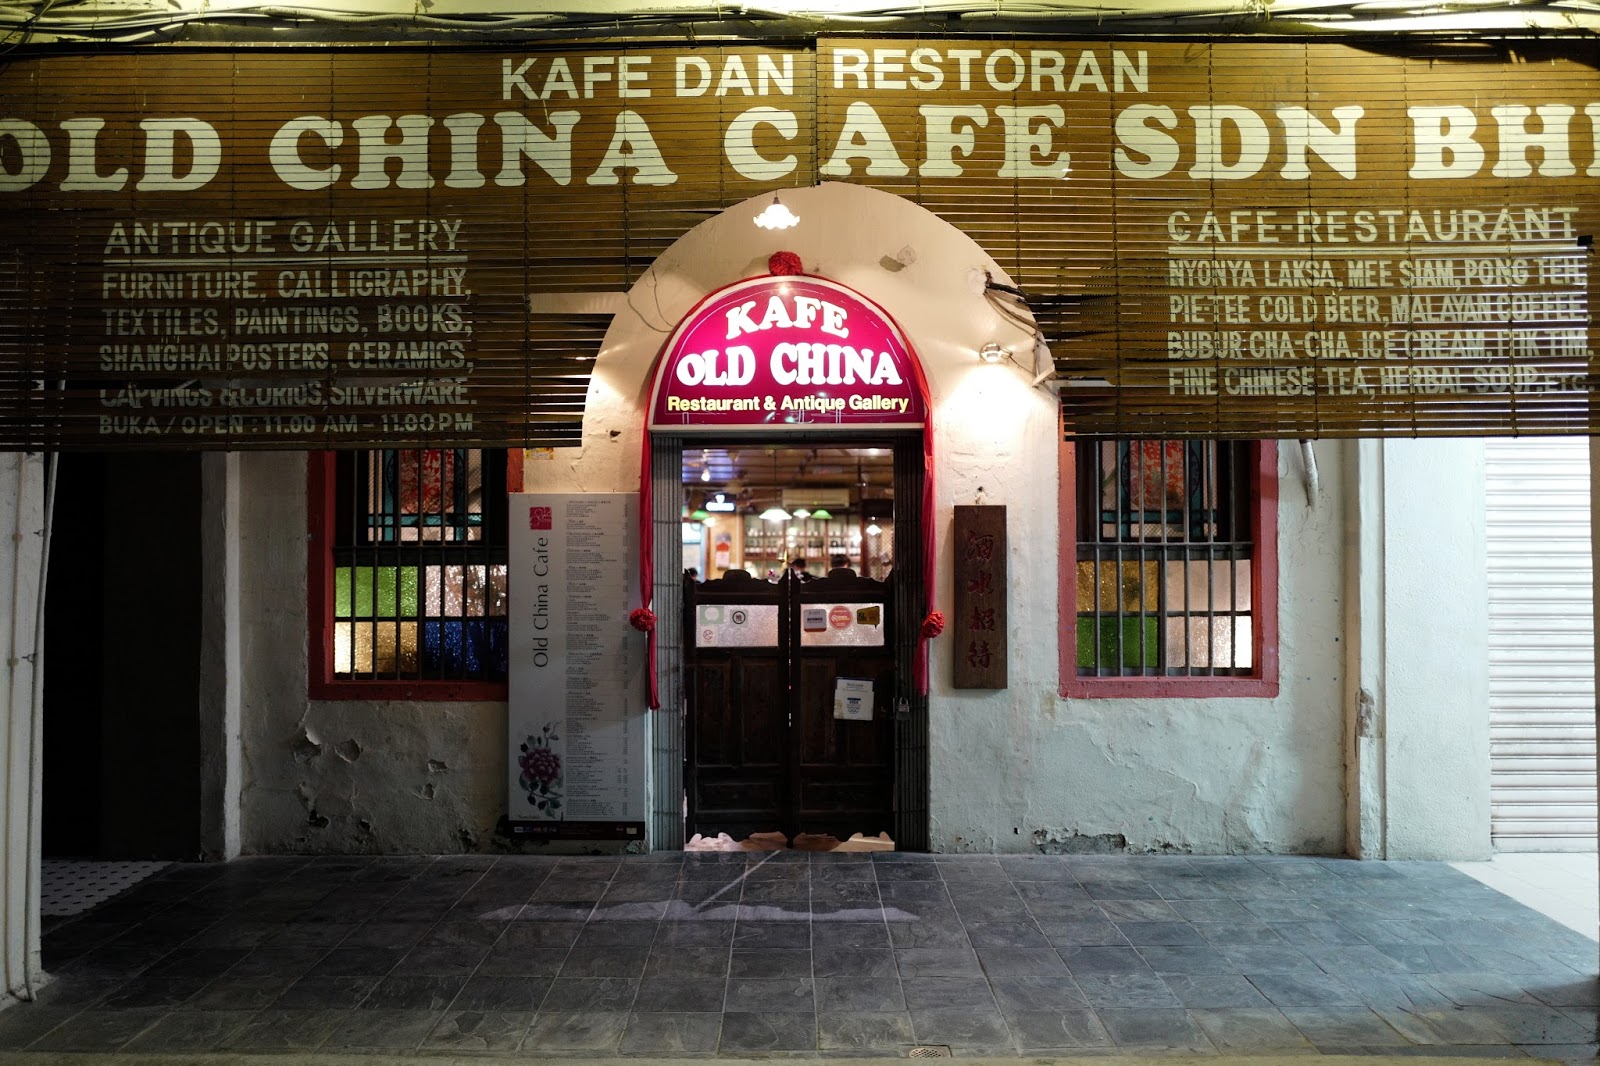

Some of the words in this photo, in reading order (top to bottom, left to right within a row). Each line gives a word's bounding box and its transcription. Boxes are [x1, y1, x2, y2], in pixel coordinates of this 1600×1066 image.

[502, 57, 652, 100] KAFE
[675, 54, 794, 96] DAN
[832, 48, 1150, 93] RESTORAN
[0, 117, 222, 192] OLD
[269, 110, 679, 192] CHINA
[723, 101, 1071, 181] CAFE
[1114, 103, 1365, 181] SDN
[103, 221, 276, 255] ANTIQUE
[288, 218, 463, 252] GALLERY
[1167, 207, 1580, 243] CAFE-RESTAURANT
[277, 267, 472, 301] CALLIGRAPHY,
[1167, 259, 1257, 289] NYONYA
[1264, 259, 1344, 291] LAKSA,
[1348, 259, 1395, 288] MEE
[1399, 257, 1461, 291] SIAM,
[1464, 256, 1529, 288] PONG
[101, 307, 227, 340] TEXTILES,
[234, 304, 369, 338] PAINTINGS,
[377, 303, 472, 337] BOOKS,
[725, 295, 850, 340] KAFE
[1169, 295, 1251, 324] PIE-TEE
[1259, 294, 1318, 324] COLD
[1324, 293, 1390, 328] BEER,
[1391, 293, 1492, 324] MALAYAN
[100, 343, 220, 372] SHANGHAI
[227, 342, 338, 373] POSTERS,
[346, 341, 474, 374] CERAMICS,
[676, 345, 757, 386] OLD
[769, 342, 903, 386] CHINA
[1167, 331, 1246, 360] BUBUR
[1249, 330, 1359, 363] CHA-CHA,
[1362, 330, 1398, 360] ICE
[1403, 330, 1493, 363] CREAM,
[1168, 368, 1219, 396] FINE
[1224, 367, 1316, 397] CHINESE
[1322, 367, 1377, 399] TEA,
[1380, 367, 1464, 395] HERBAL
[1473, 367, 1543, 397] SOUP,
[667, 395, 760, 412] Restaurant
[763, 396, 776, 411] &
[780, 394, 846, 414] Antique
[848, 393, 909, 413] Gallery
[99, 415, 162, 435] BUKA
[181, 414, 244, 435] OPEN
[263, 414, 316, 434] 11.00
[323, 414, 359, 433] AM
[532, 537, 549, 577] Cafe
[532, 584, 549, 631] China
[532, 637, 549, 668] Old
